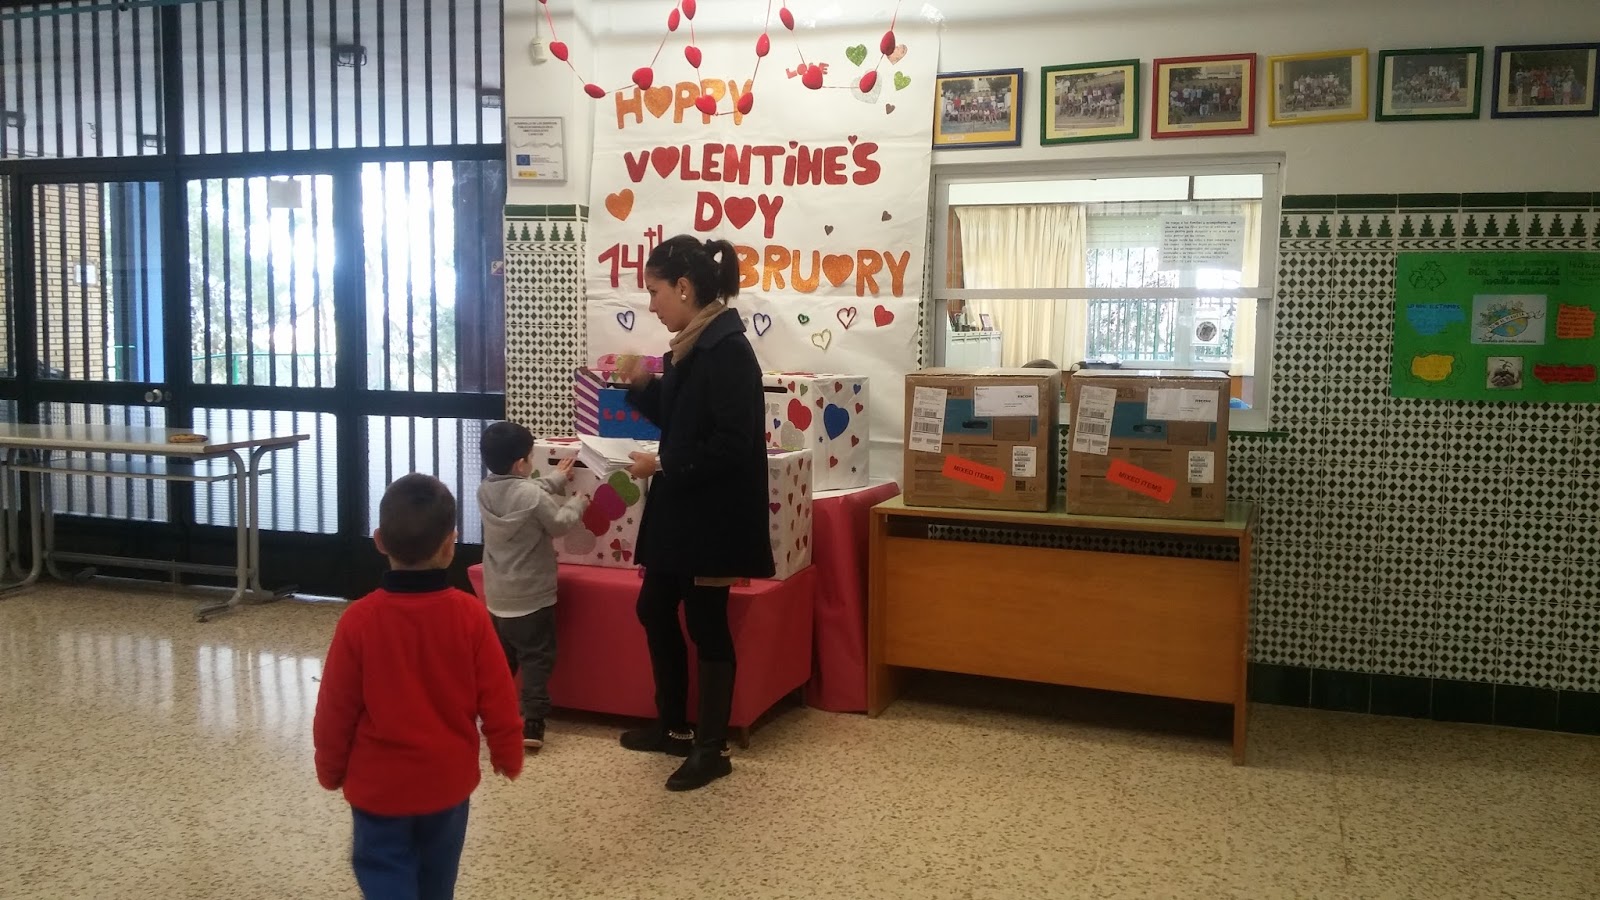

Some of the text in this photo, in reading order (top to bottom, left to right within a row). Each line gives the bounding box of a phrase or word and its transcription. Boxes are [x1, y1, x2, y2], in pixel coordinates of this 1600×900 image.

[785, 62, 829, 79] LOE
[953, 465, 994, 482] MIXED ITEMS
[1118, 472, 1162, 492] MIXED ITEMS
